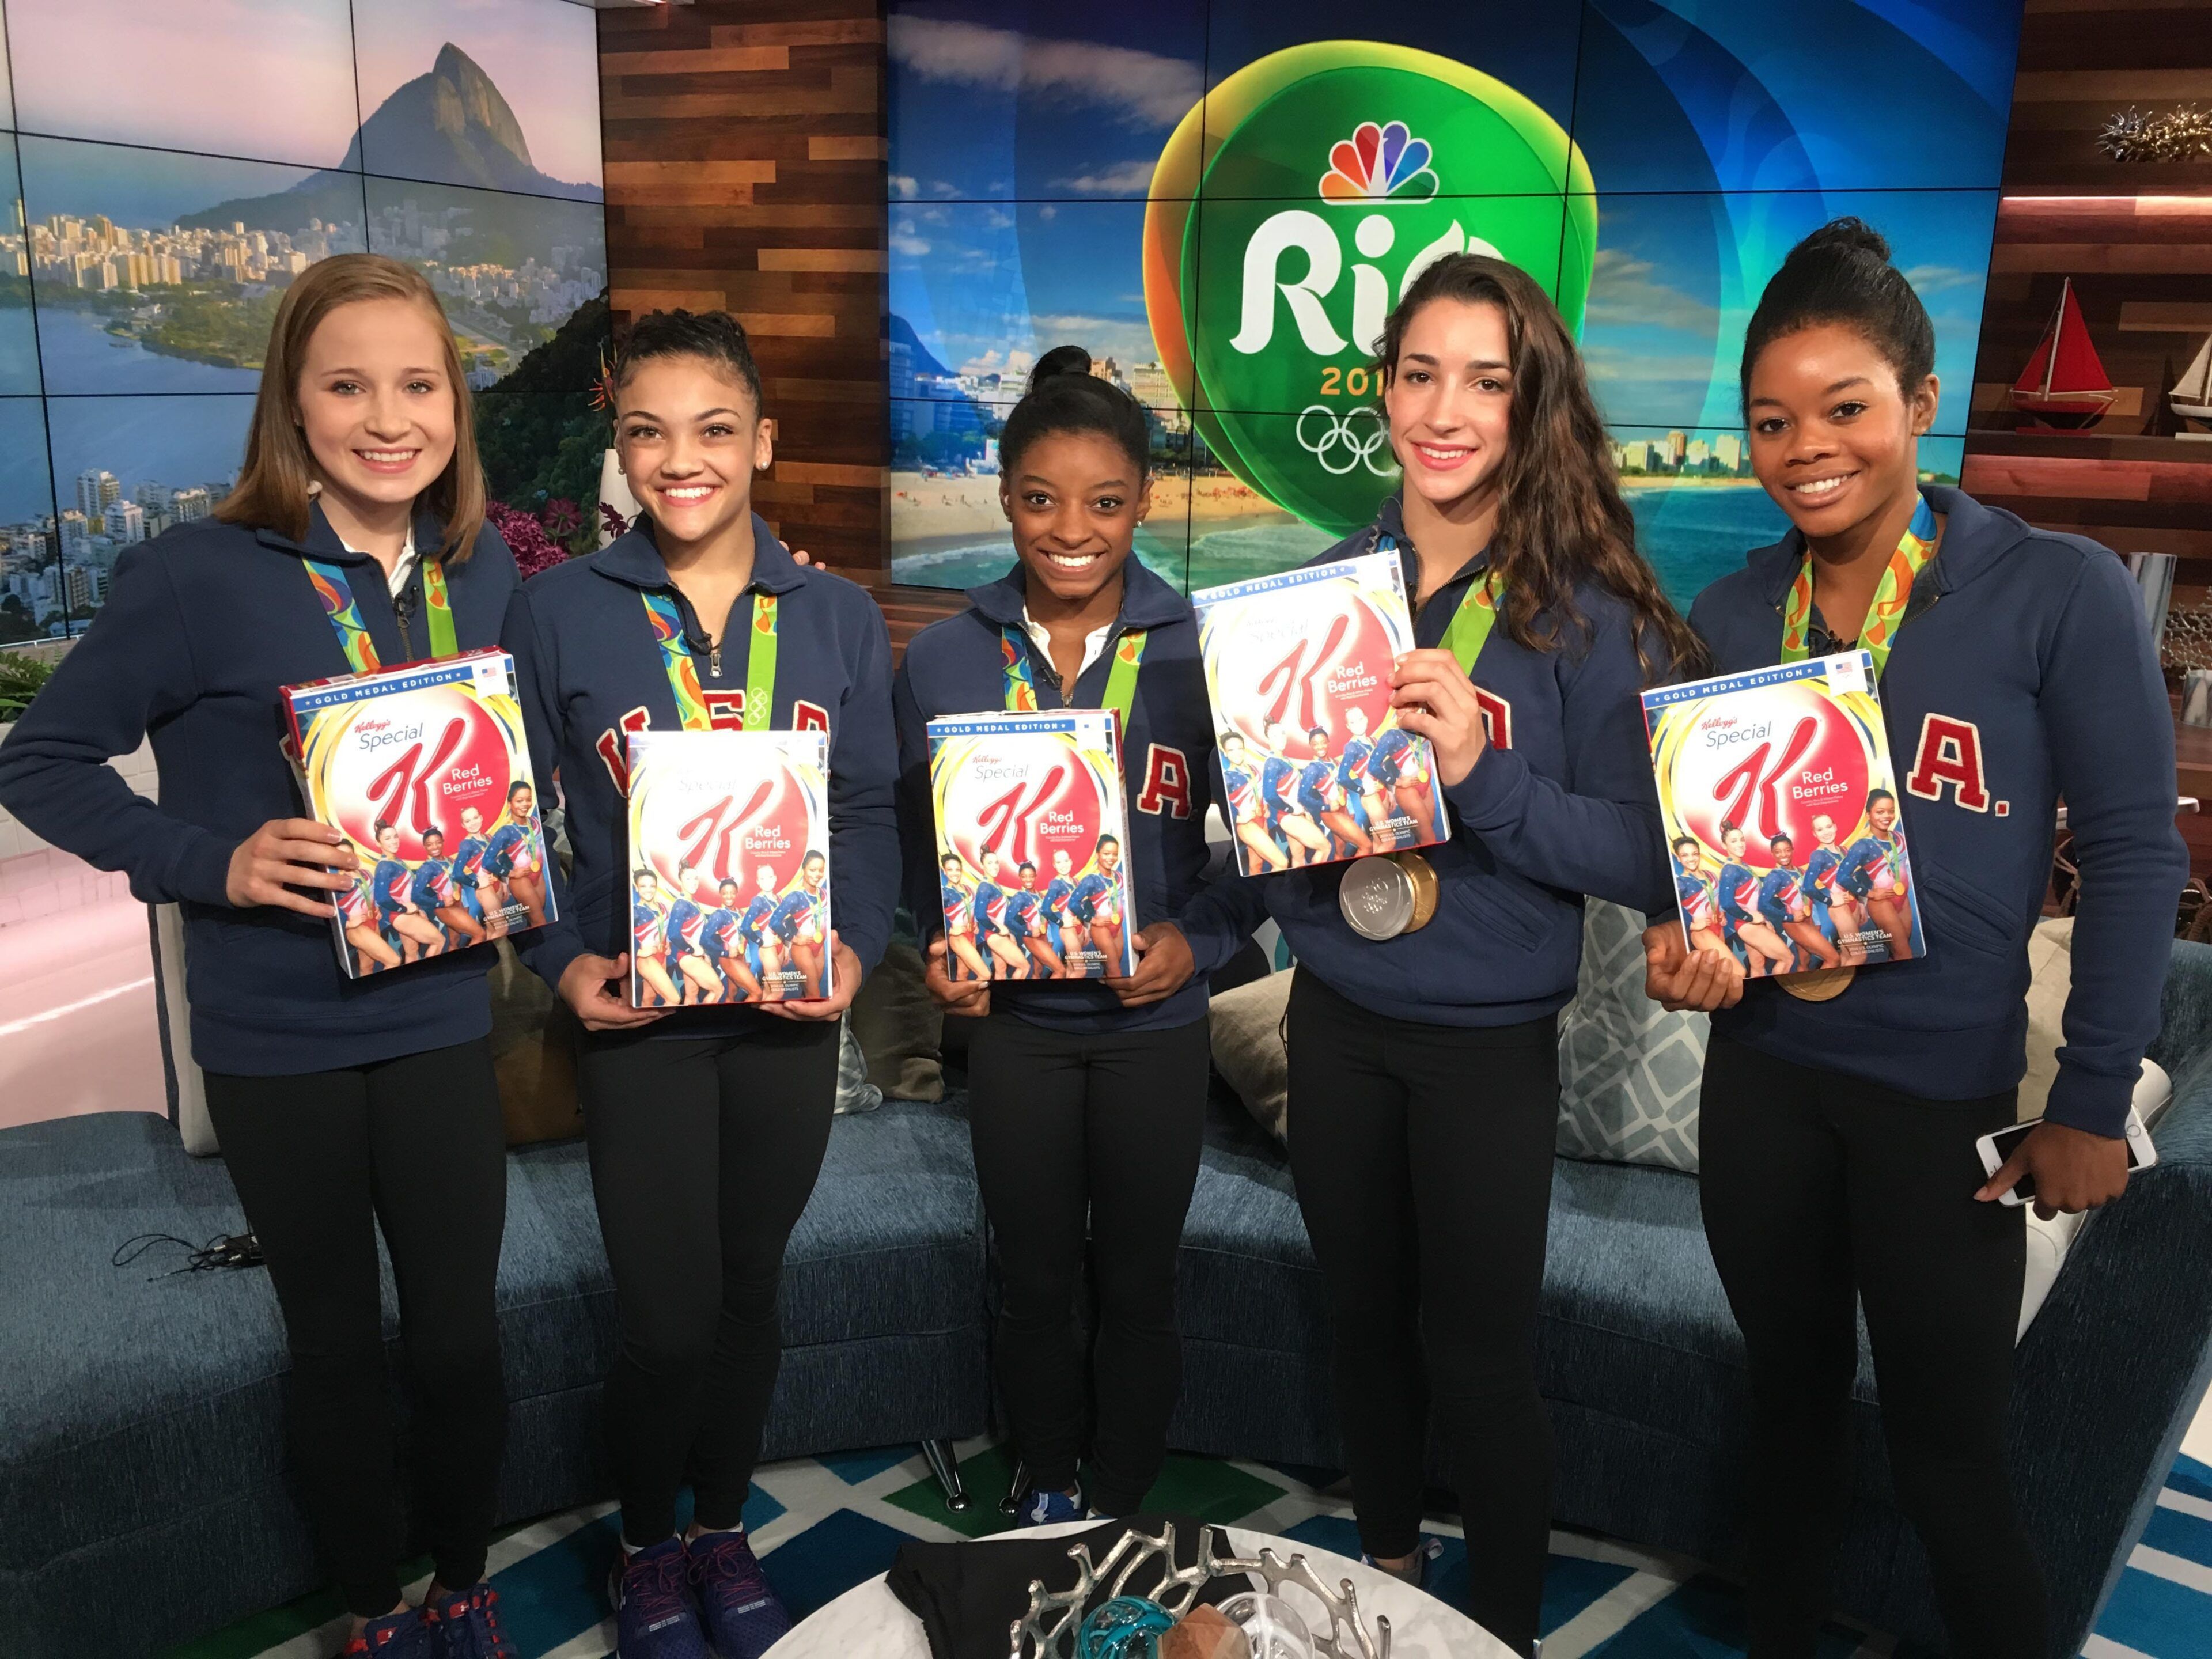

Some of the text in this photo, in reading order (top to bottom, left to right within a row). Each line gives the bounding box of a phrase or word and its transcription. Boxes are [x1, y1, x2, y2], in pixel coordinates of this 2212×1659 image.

[1229, 210, 1506, 356] Ri
[1320, 366, 1384, 396] 201
[1289, 568, 1337, 584] EDITION
[1256, 614, 1350, 733] K
[1336, 661, 1364, 679] Red
[315, 673, 453, 705] GOLD MEDAL EDITION
[1328, 676, 1377, 693] Berries
[1664, 669, 1802, 701] GOLD MEDAL EDITION
[354, 719, 391, 733] Kellogg's
[944, 725, 971, 733] GOLD
[976, 724, 1010, 732] MEDAL
[1702, 717, 1737, 730] Kellogg's
[359, 722, 424, 752] Special
[1706, 721, 1771, 750] Special
[366, 717, 466, 835] K
[452, 763, 479, 781] Red
[975, 765, 1028, 781] Special
[1713, 717, 1817, 839] K
[1802, 767, 1833, 784] Red
[443, 777, 493, 795] Berries
[1793, 782, 1848, 799] Berries
[976, 765, 1065, 865] K
[1048, 810, 1073, 823] Red
[677, 779, 774, 882] K
[755, 825, 781, 838] Red
[1040, 822, 1084, 834] Berries
[745, 837, 791, 849] Berries
[1837, 935, 1875, 944] GYMNASTICS
[1855, 929, 1884, 937] WOMEN'S
